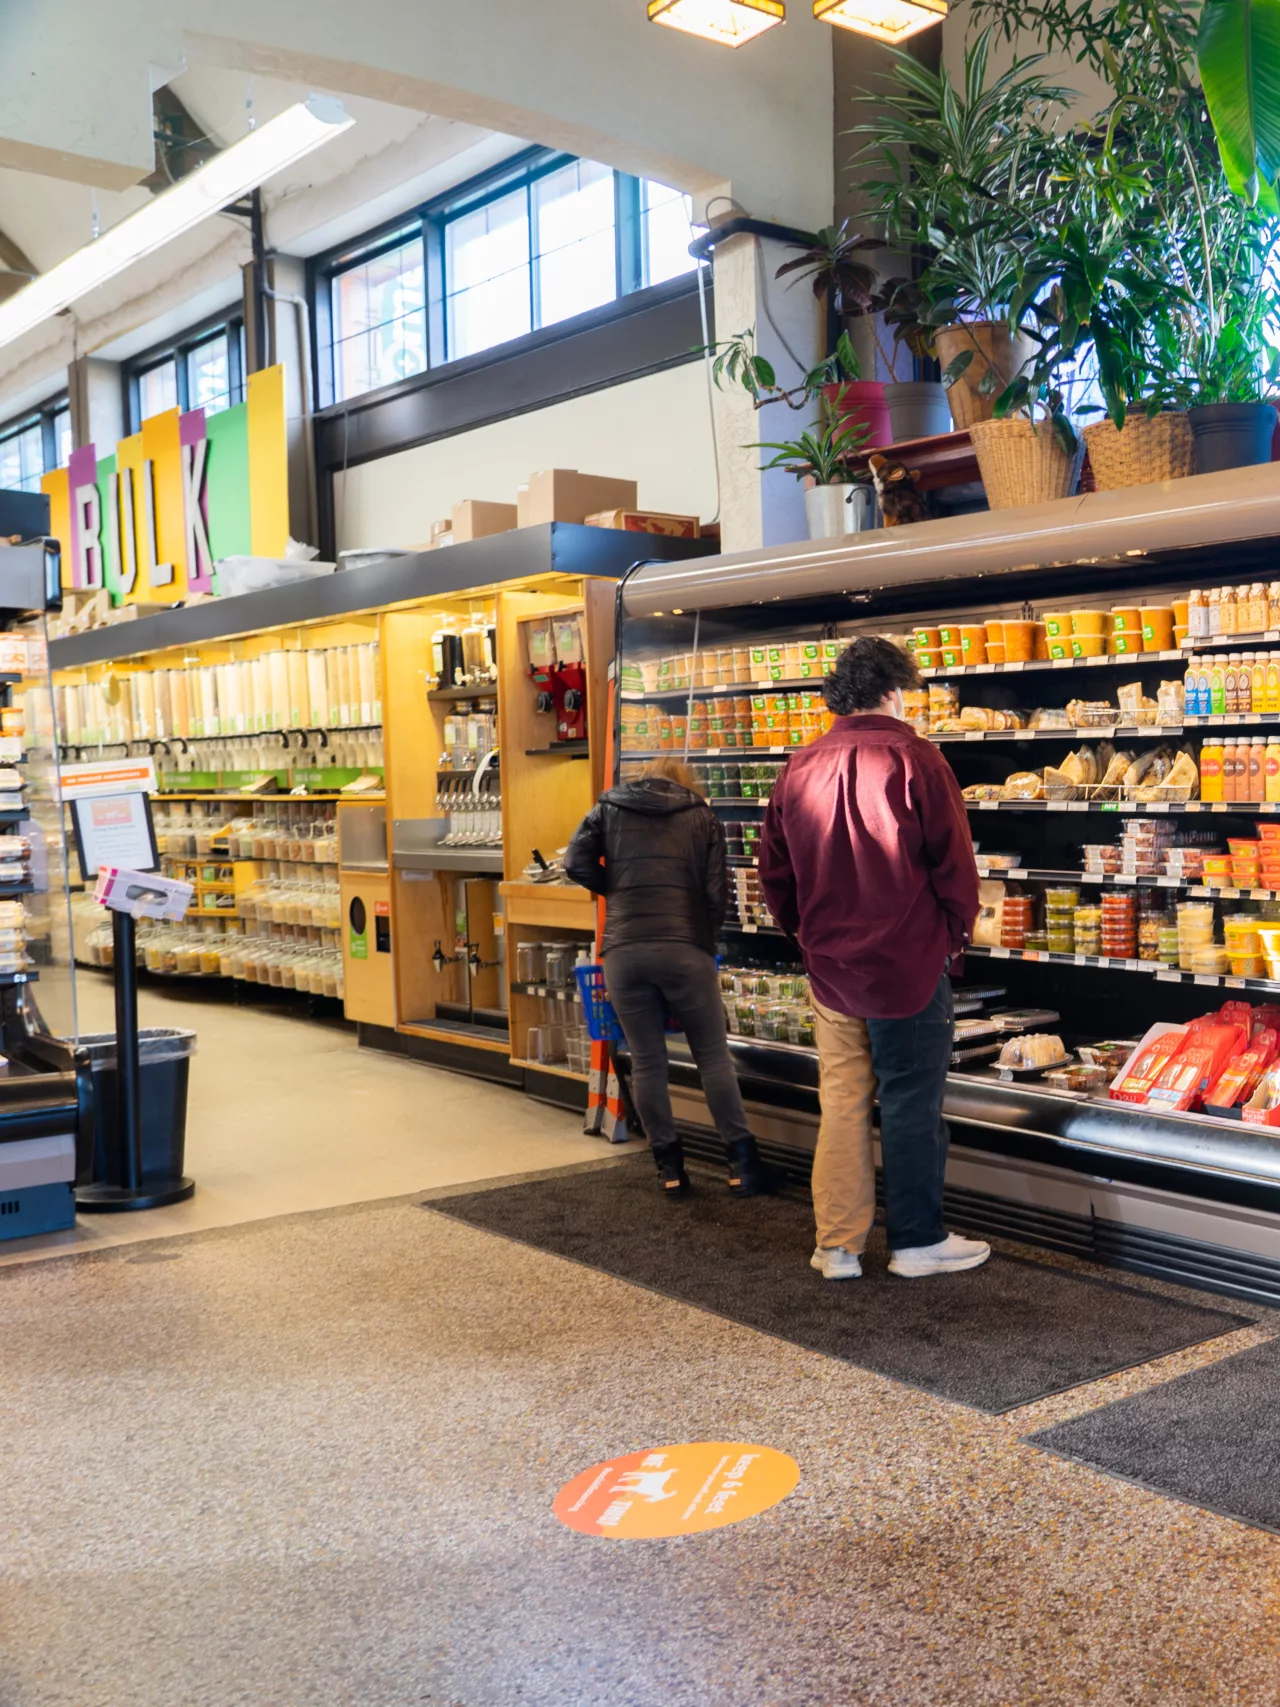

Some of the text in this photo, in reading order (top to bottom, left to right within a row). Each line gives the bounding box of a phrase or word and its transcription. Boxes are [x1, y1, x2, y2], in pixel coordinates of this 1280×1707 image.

[76, 439, 216, 594] BULK
[704, 1454, 761, 1514] keep 6 feet
